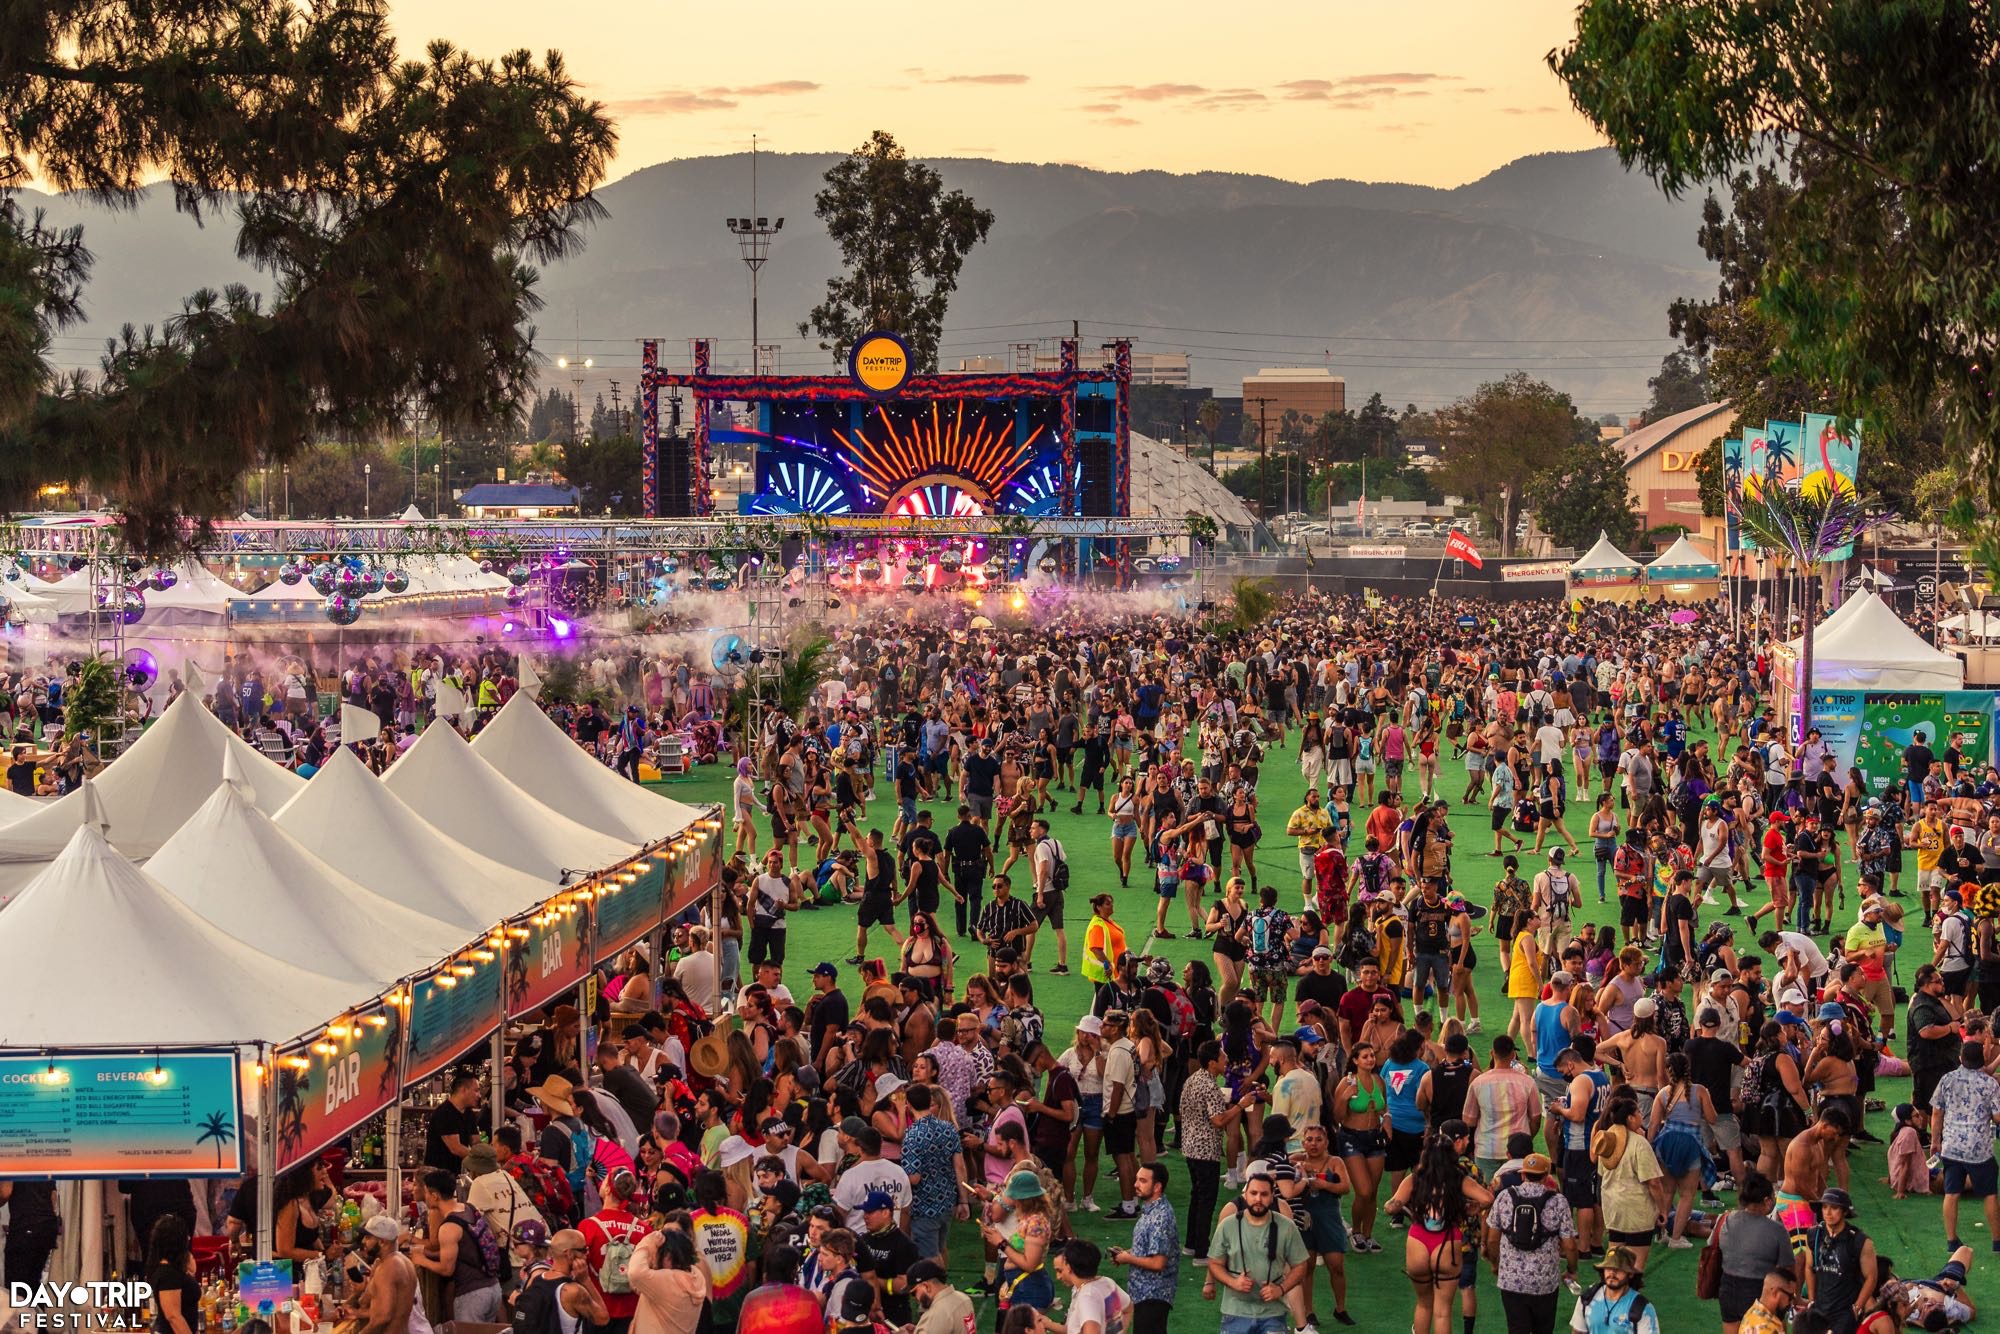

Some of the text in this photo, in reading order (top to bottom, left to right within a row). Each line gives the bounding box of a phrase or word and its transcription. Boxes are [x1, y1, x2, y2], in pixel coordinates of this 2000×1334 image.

[1449, 538, 1467, 551] FULL
[1506, 569, 1550, 578] EMERGENCY
[1595, 574, 1617, 583] BAR
[1919, 583, 1934, 593] CH
[242, 687, 252, 697] 50
[1812, 695, 1827, 705] AY
[1675, 730, 1686, 741] 50
[684, 848, 701, 889] BAR
[1428, 922, 1438, 937] 3
[542, 929, 563, 979] BAR
[96, 1072, 168, 1083] BEVERAG
[325, 1050, 361, 1116] BAR
[710, 1229, 733, 1238] MEDAL
[714, 1253, 733, 1263] 1992
